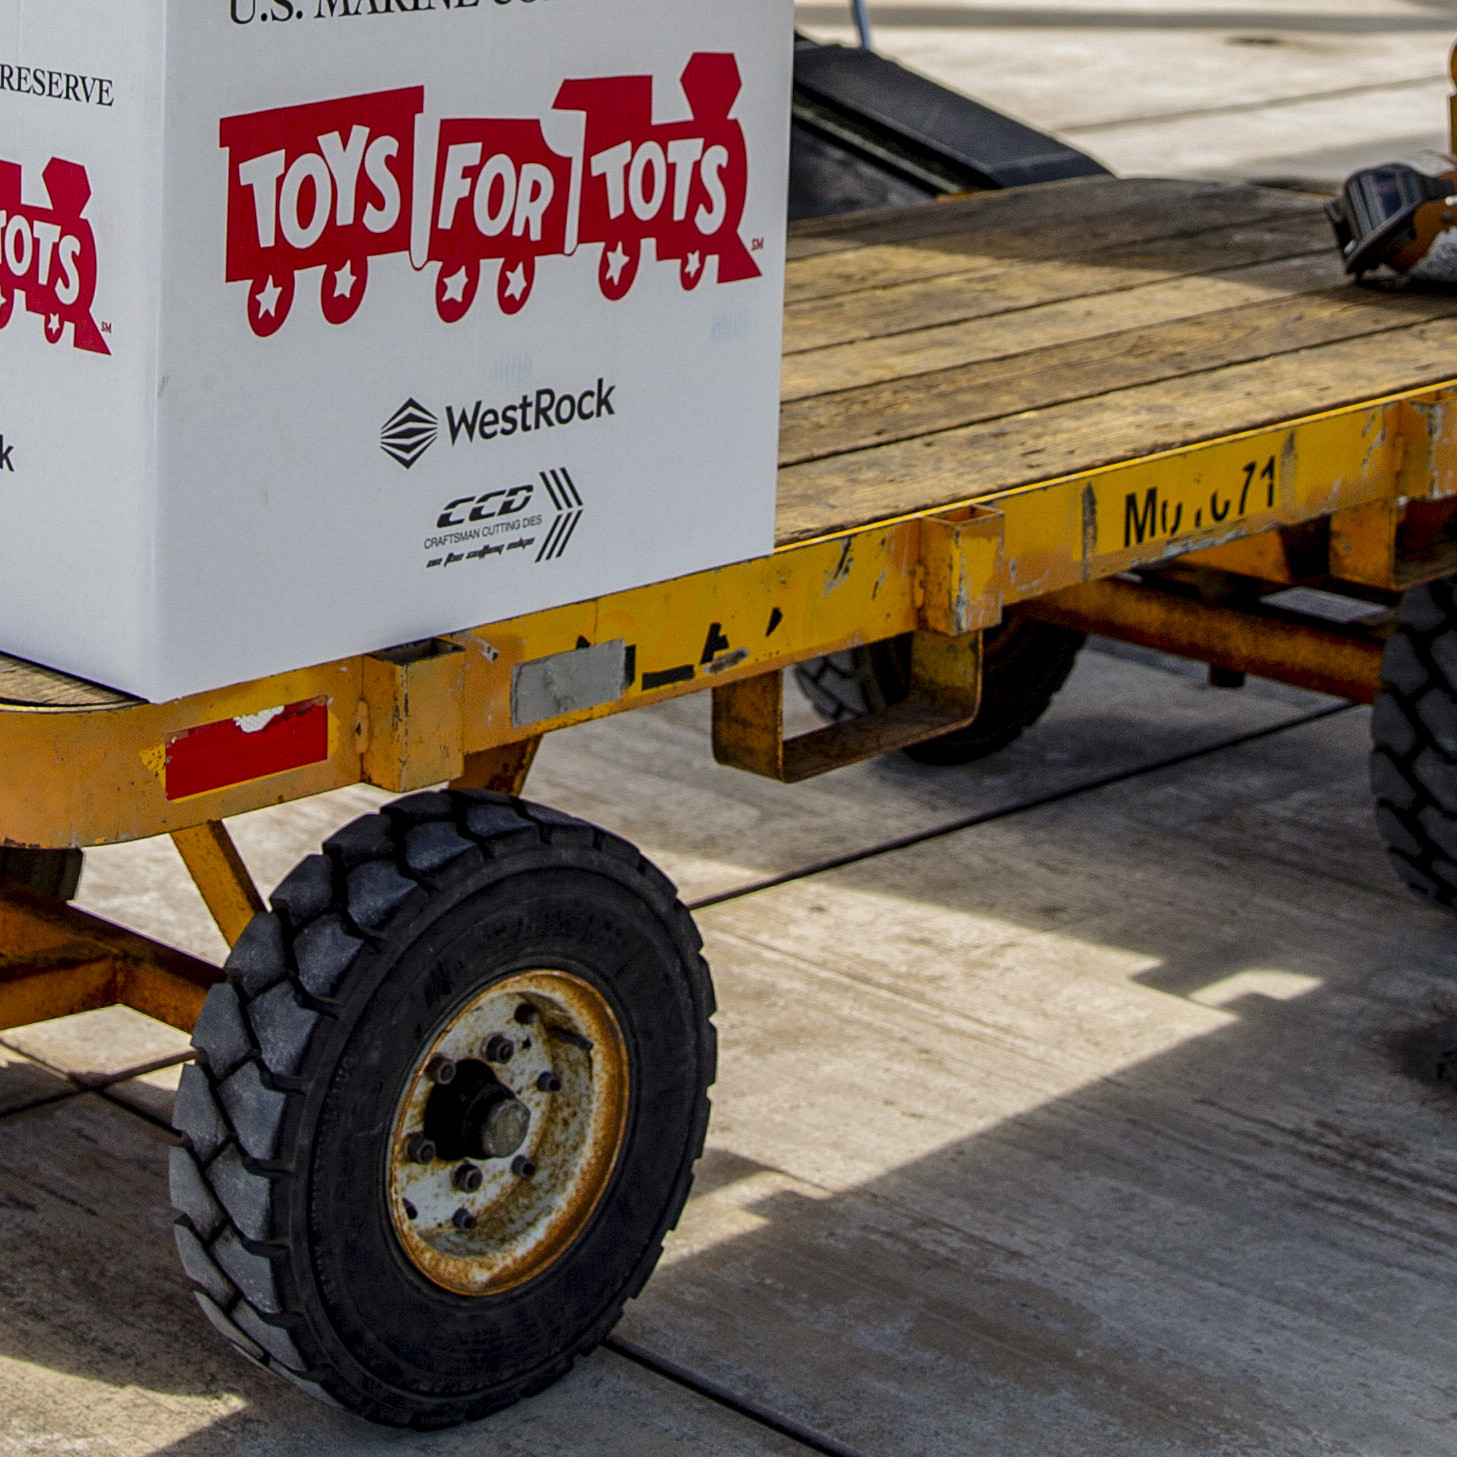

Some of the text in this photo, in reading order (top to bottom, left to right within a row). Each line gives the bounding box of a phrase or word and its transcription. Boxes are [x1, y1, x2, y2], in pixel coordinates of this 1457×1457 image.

[239, 125, 729, 249] TOYS FOR TOTS
[445, 378, 615, 446] WestRock
[424, 514, 543, 549] CRAFTSMAN CUTTING DIES
[437, 484, 533, 528] CCD
